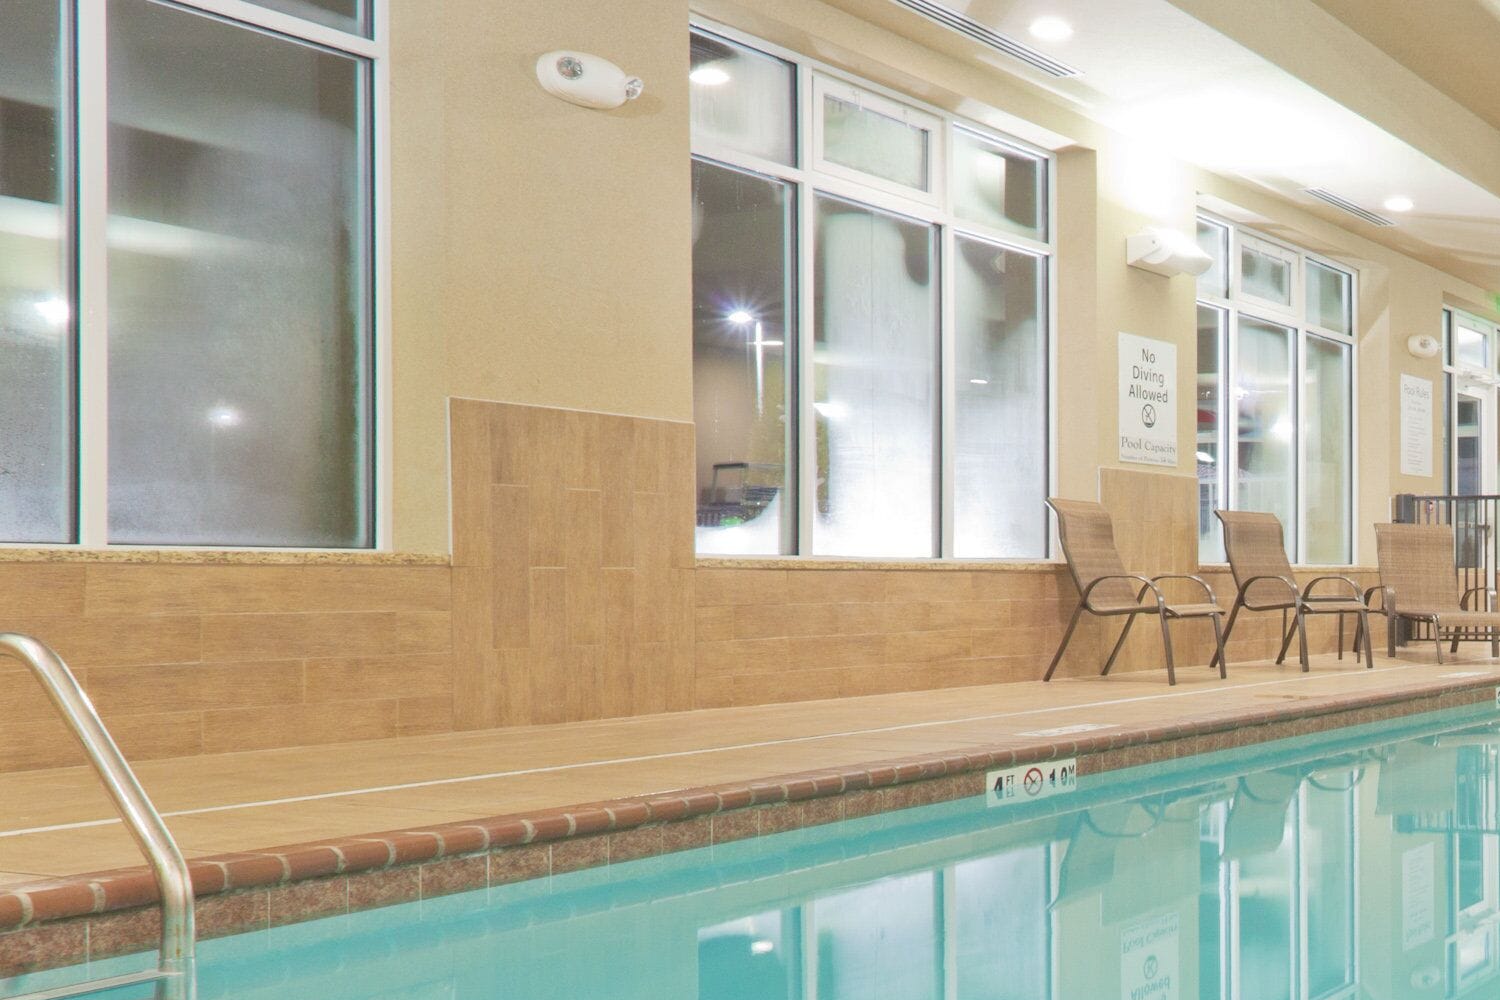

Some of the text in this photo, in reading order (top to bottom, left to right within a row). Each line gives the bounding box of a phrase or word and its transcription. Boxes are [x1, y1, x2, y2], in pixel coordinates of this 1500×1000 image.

[1142, 348, 1155, 364] No
[1132, 365, 1164, 387] Diving
[1128, 384, 1168, 403] Allowed
[1121, 436, 1176, 456] Pool Capacity
